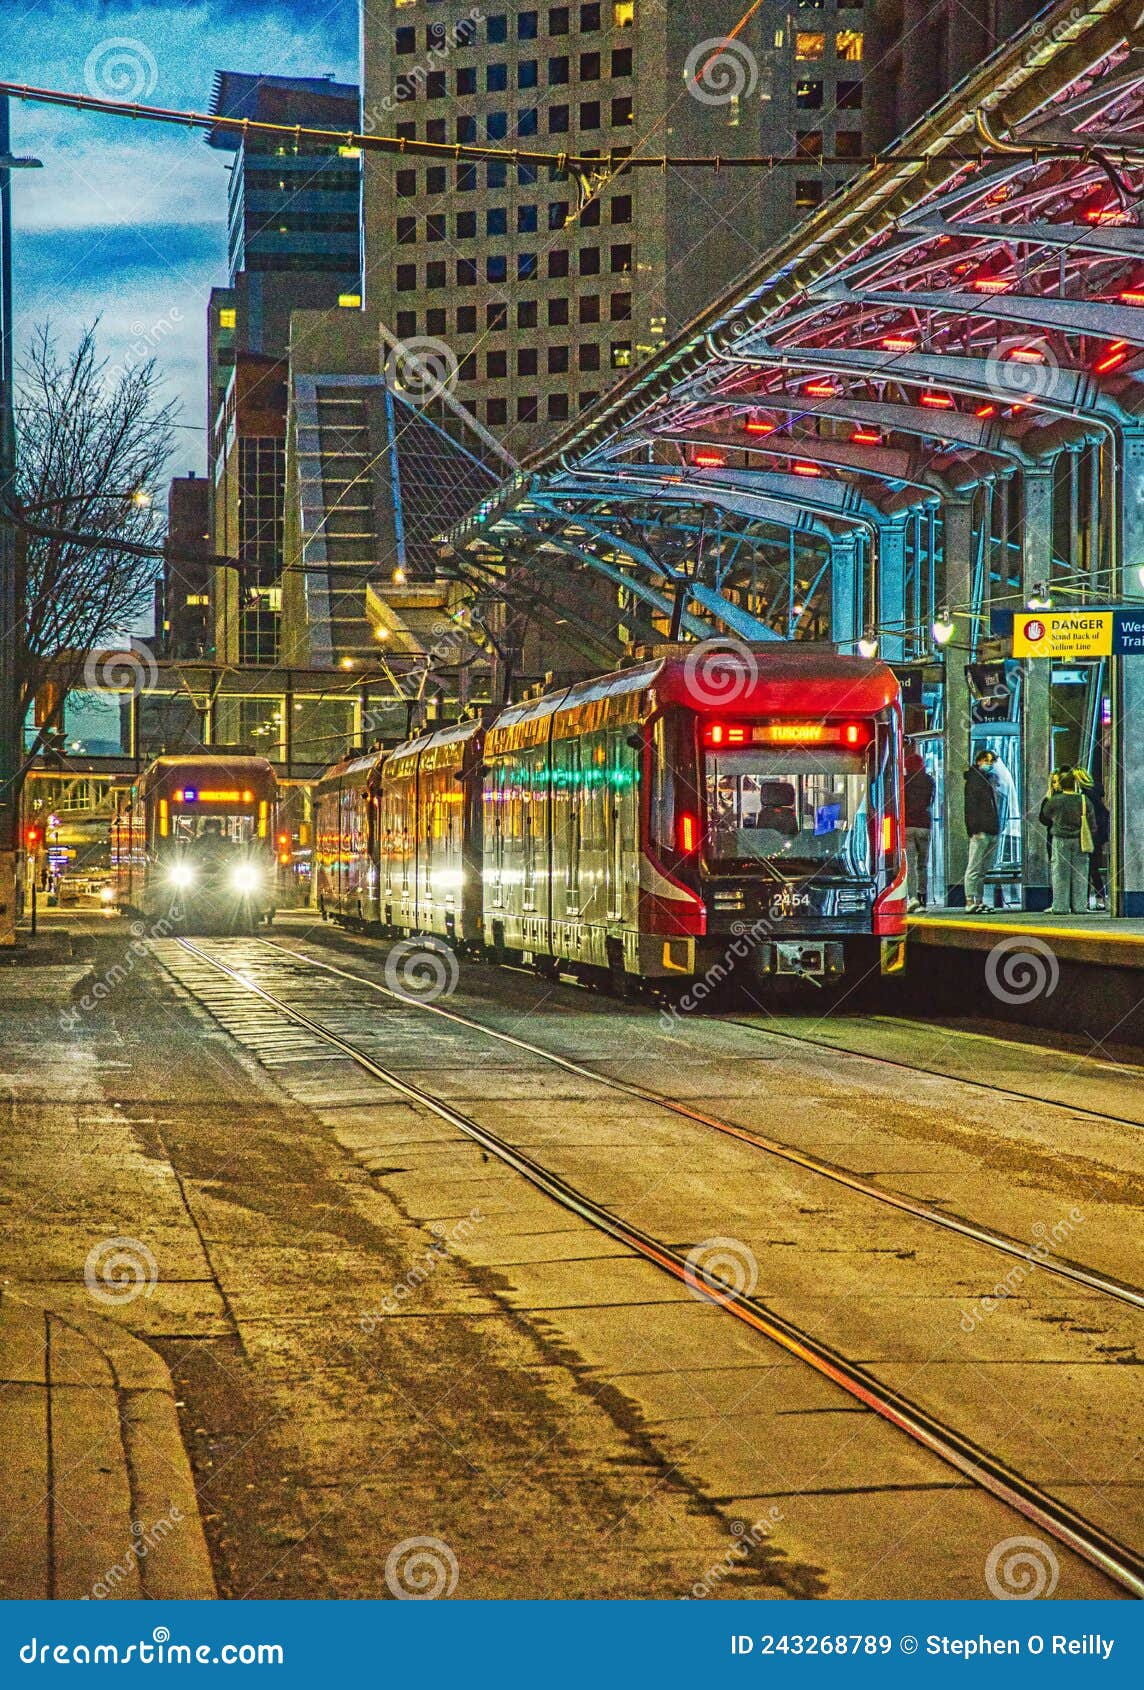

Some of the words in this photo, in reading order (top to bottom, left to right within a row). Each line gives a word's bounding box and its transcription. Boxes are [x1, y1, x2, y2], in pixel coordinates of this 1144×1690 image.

[1051, 620, 1103, 629] DANGER
[769, 725, 822, 742] TUSCANY
[773, 893, 811, 906] 2454
